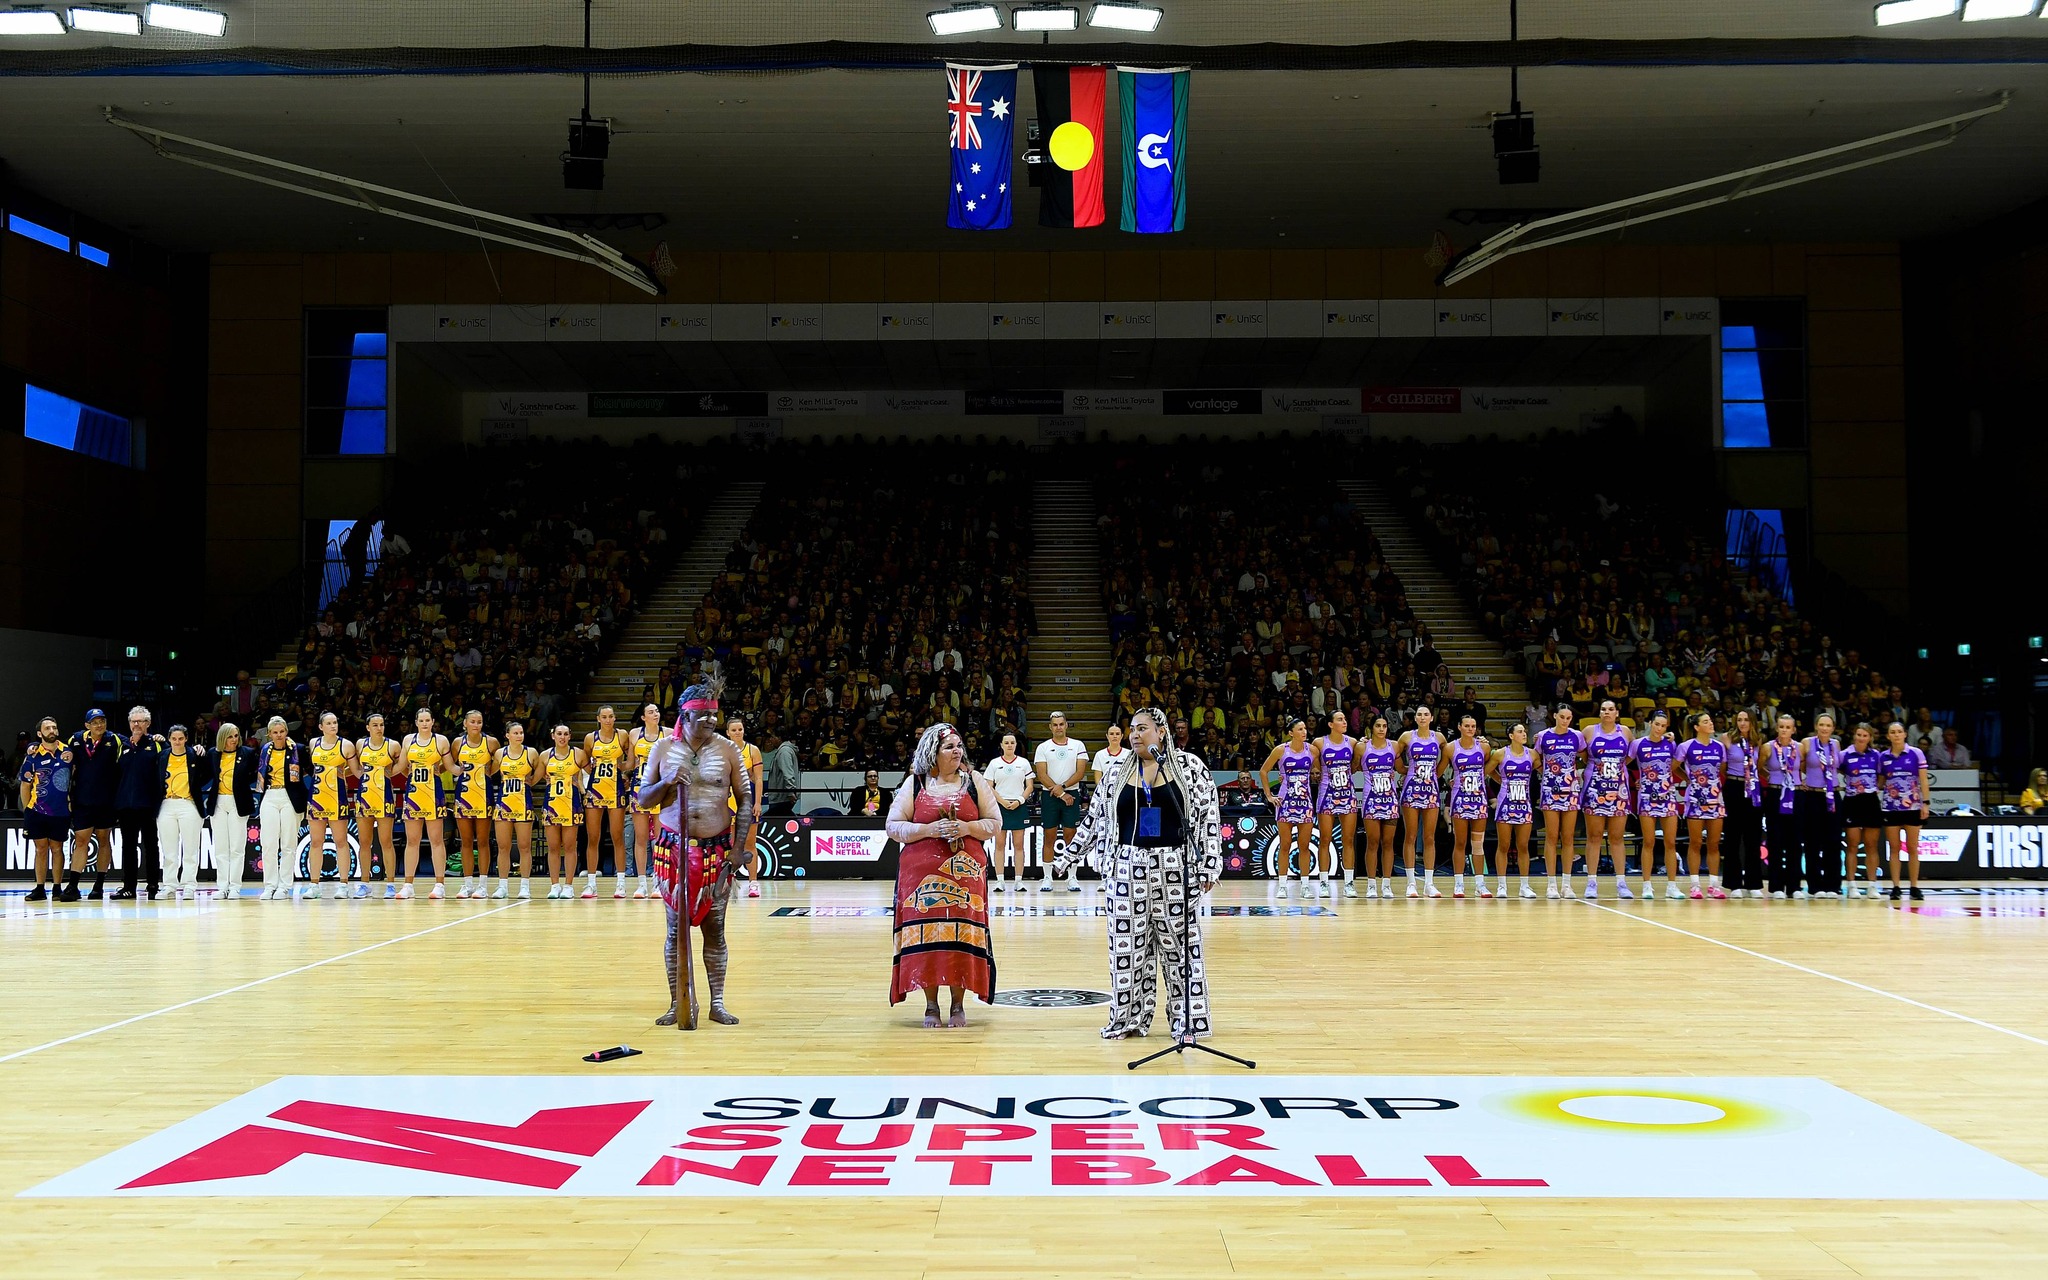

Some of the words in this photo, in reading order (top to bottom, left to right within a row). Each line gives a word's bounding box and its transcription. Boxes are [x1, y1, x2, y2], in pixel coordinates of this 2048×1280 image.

[793, 317, 818, 326] UniSC
[903, 317, 928, 326] UniSC
[1014, 316, 1040, 325] UniSC
[1125, 315, 1151, 324] UniSC
[1236, 315, 1263, 323] UniSC
[1349, 314, 1374, 323] UniSC
[1461, 313, 1487, 321] UniSC
[1573, 312, 1599, 321] UniSC
[1685, 311, 1712, 320] UniSC
[461, 319, 486, 327] UniSC
[571, 319, 597, 327] UniSC
[682, 318, 707, 327] UniSC
[593, 396, 665, 410] harmony
[833, 398, 858, 407] Toyota
[1131, 397, 1155, 406] Toyota
[1187, 398, 1239, 412] vantage
[1328, 398, 1351, 406] Coast
[1387, 393, 1454, 405] GILBERT
[1492, 397, 1526, 405] Sunshine
[1527, 397, 1548, 405] Coast
[520, 403, 553, 411] Sunshine
[555, 403, 576, 411] Coast
[414, 768, 429, 783] GD
[598, 763, 614, 778] GS
[1417, 765, 1432, 780] GK
[1603, 762, 1617, 778] GS
[1333, 771, 1348, 787] GD
[1464, 776, 1479, 792] GA
[505, 778, 521, 793] WD
[556, 780, 564, 795] C
[1294, 780, 1302, 796] C
[1373, 778, 1391, 793] WD
[1509, 785, 1526, 801] WA
[385, 802, 395, 814] 30
[1931, 798, 1955, 806] Toyota
[437, 805, 448, 817] 23
[573, 813, 584, 825] 32
[702, 1097, 1459, 1120] SUNCORP
[670, 1124, 1280, 1151] SUPER
[636, 1155, 1550, 1187] NETBALL
